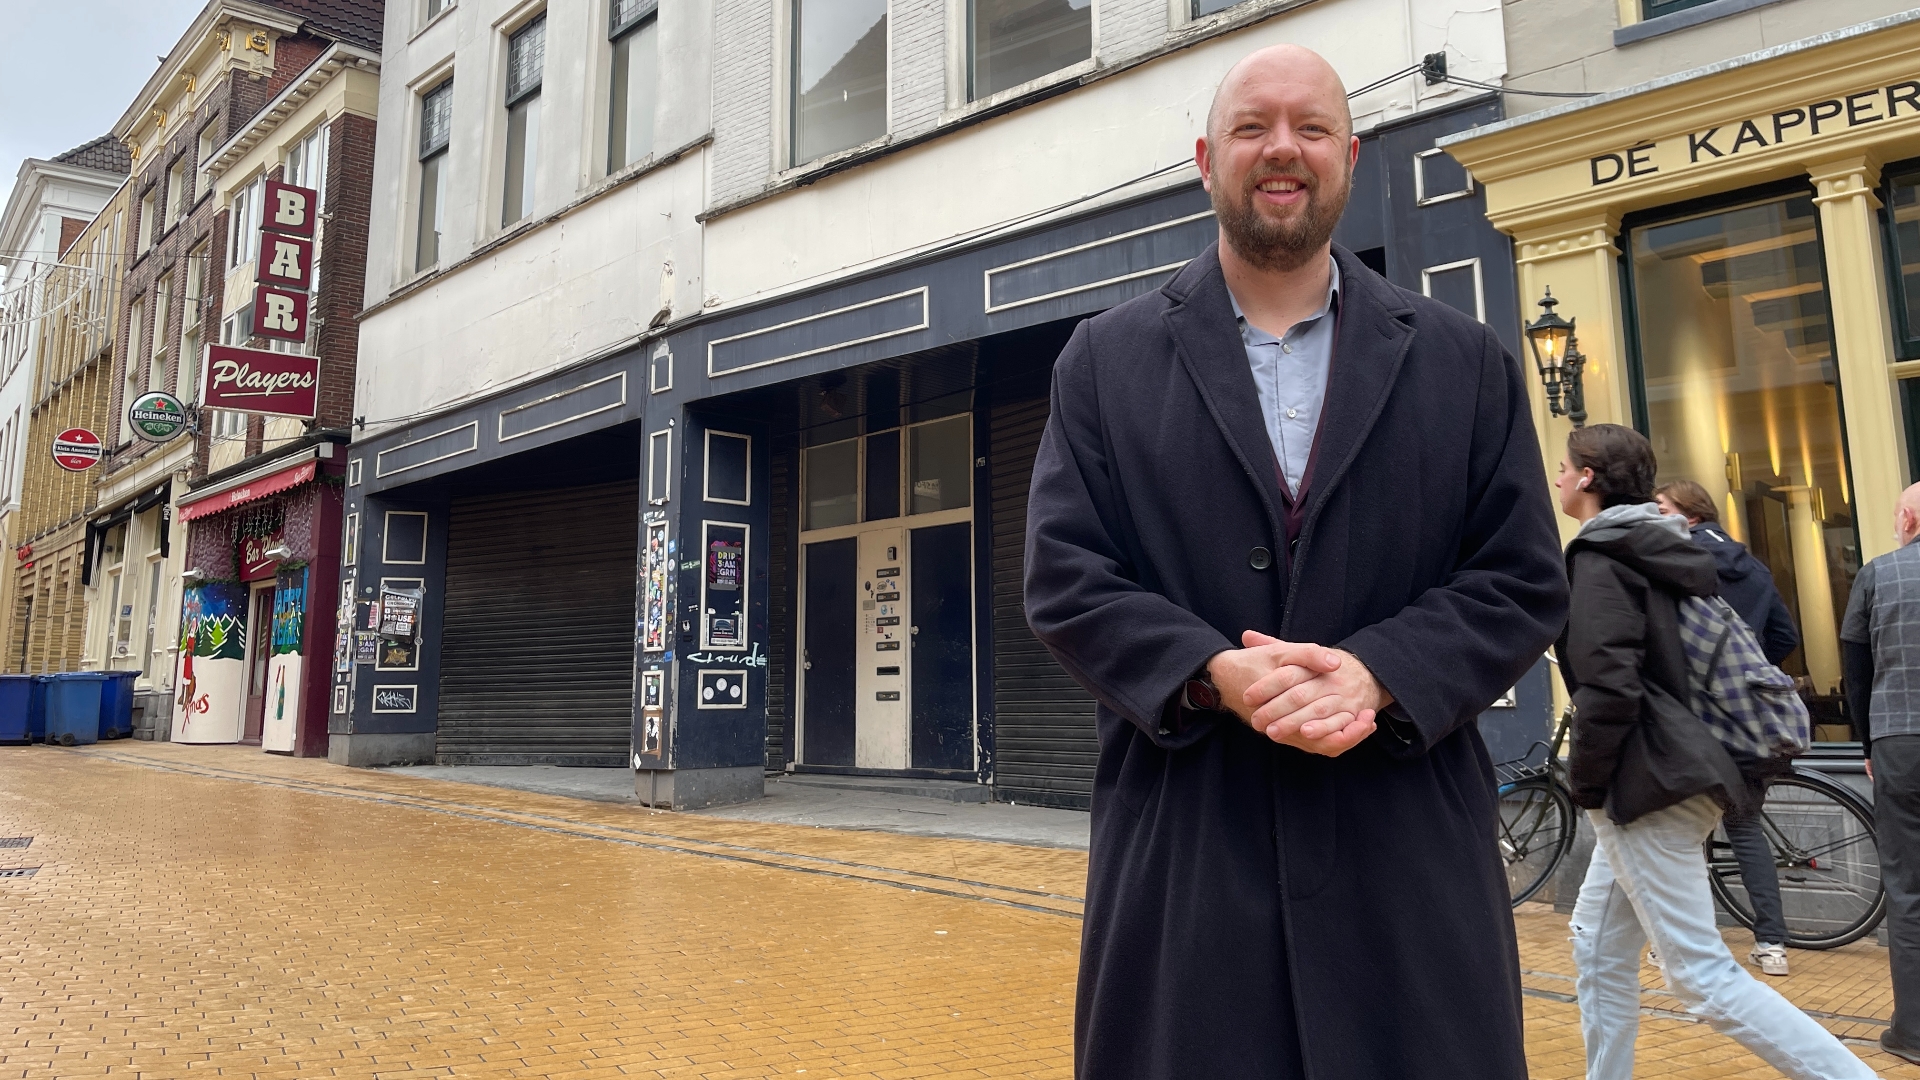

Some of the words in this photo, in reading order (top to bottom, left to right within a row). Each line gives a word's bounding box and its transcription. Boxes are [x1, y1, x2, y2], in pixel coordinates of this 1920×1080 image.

[1689, 80, 1920, 163] KAPPER
[263, 188, 306, 333] BAR
[212, 361, 315, 396] Players
[134, 410, 182, 423] Heineken
[246, 540, 260, 565] Bar
[717, 551, 736, 560] DRIP
